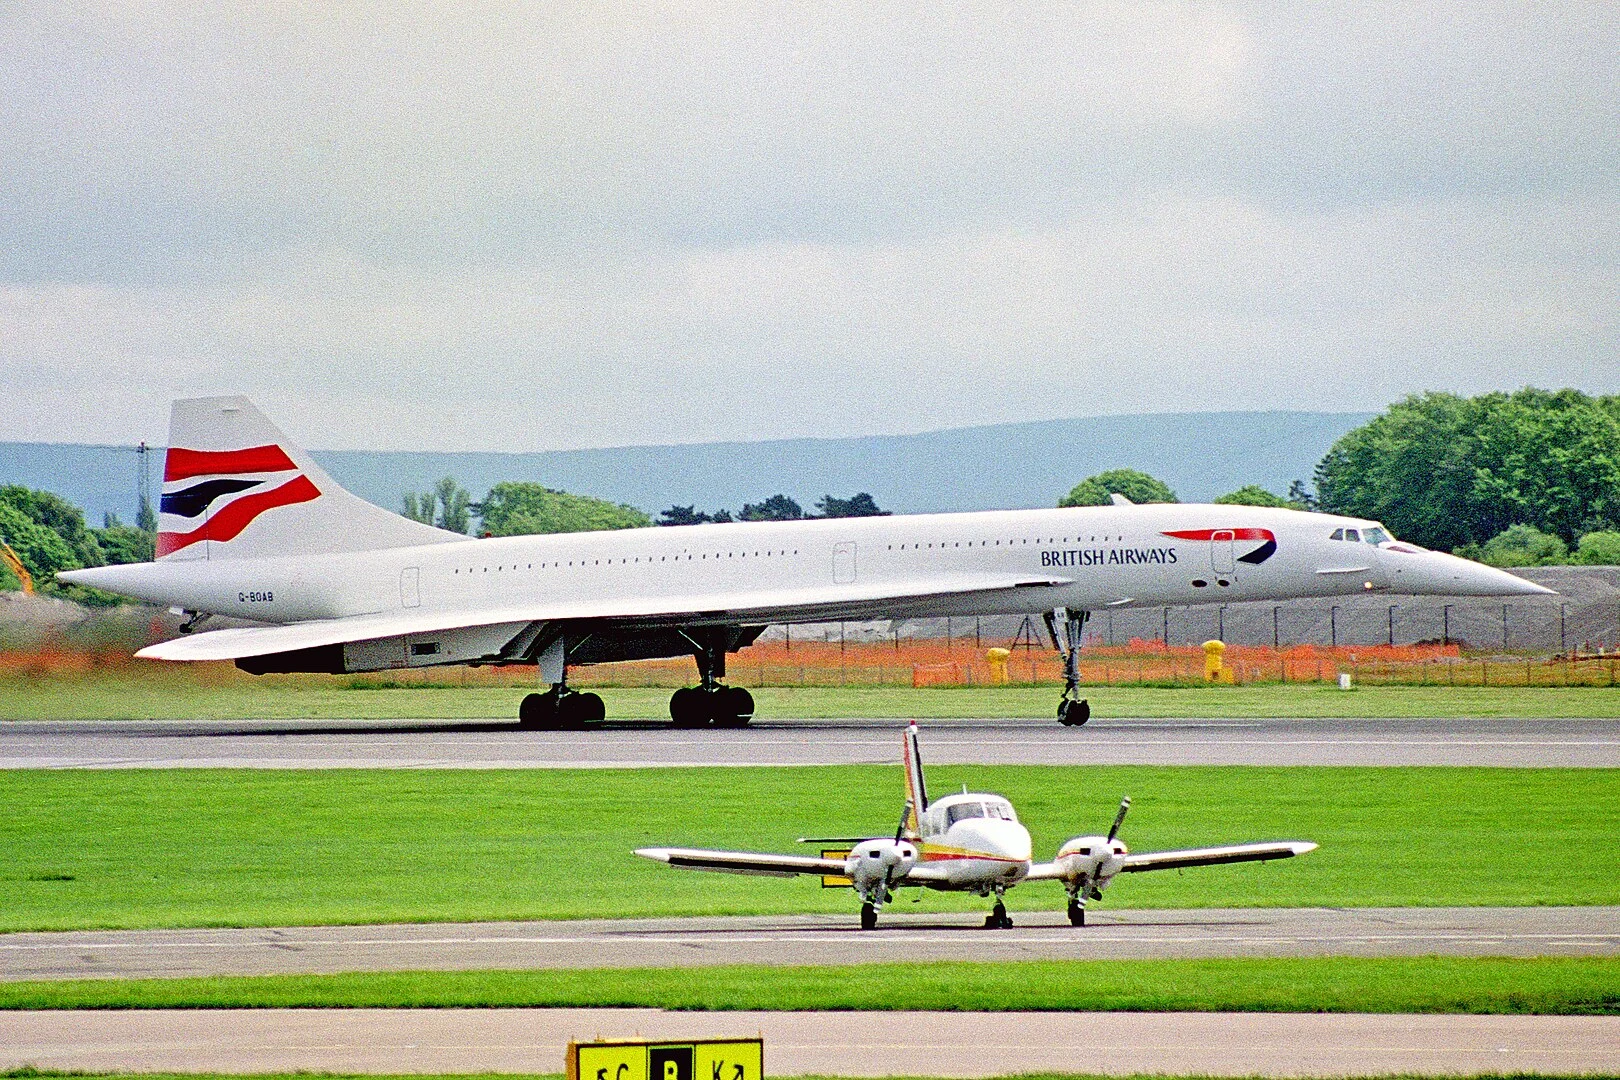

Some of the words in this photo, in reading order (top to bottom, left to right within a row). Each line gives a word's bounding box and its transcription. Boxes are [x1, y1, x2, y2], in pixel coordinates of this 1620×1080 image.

[1041, 550, 1104, 567] BRITISH
[1108, 548, 1177, 565] AIRWAYS
[238, 591, 273, 602] G-BOAB
